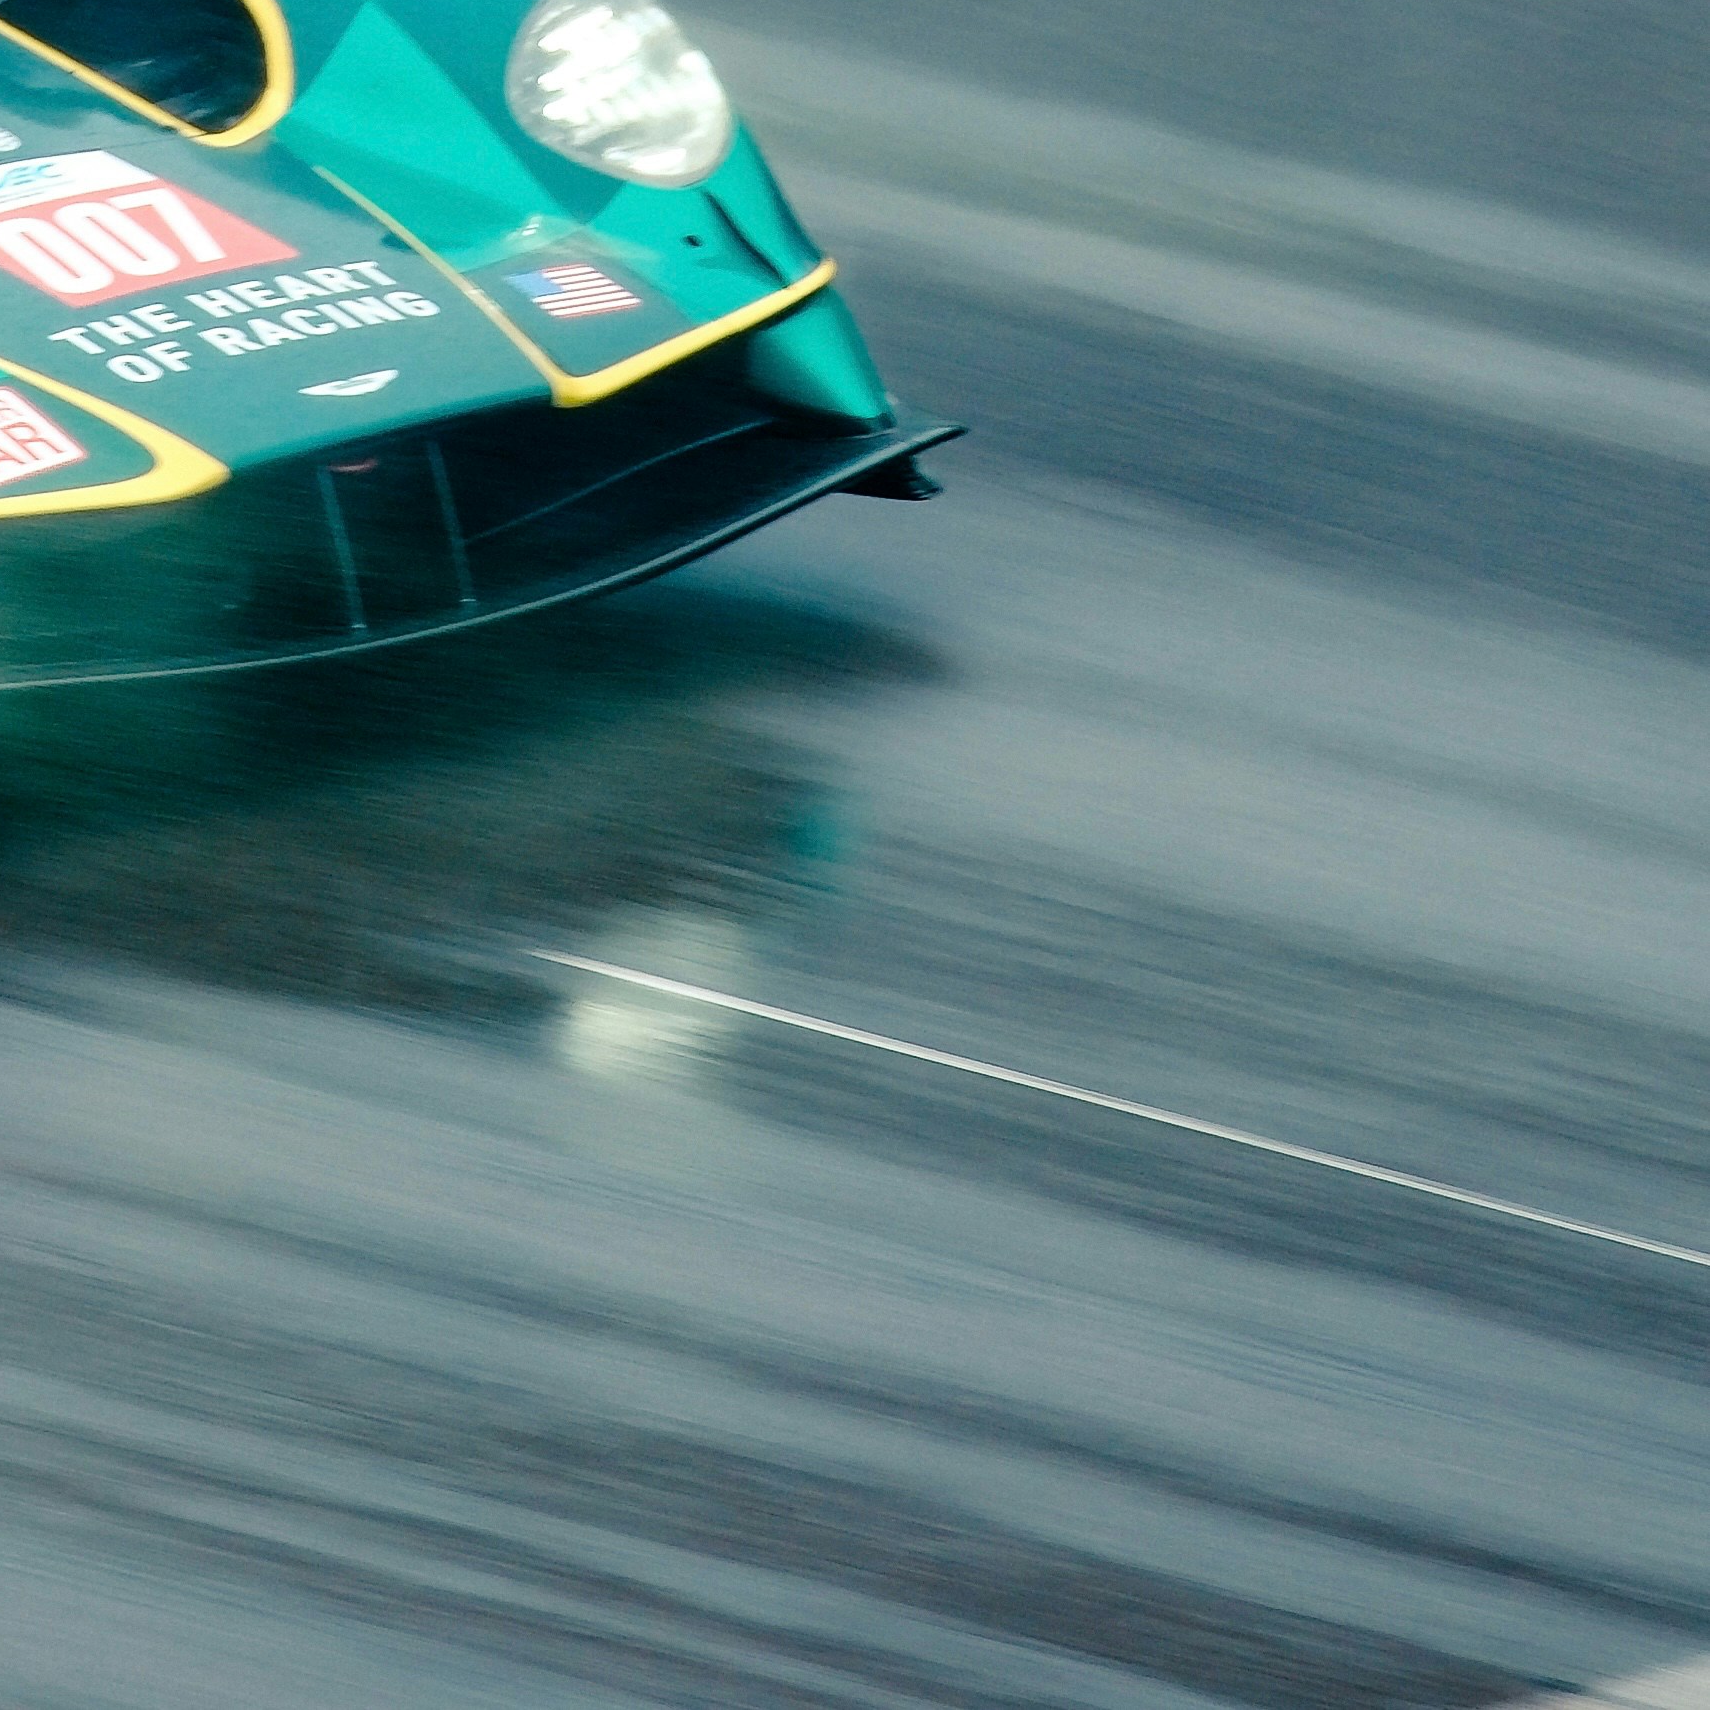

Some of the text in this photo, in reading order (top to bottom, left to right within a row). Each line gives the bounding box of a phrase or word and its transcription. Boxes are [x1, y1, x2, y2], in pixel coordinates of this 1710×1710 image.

[47, 260, 398, 355] THE HEART
[106, 291, 441, 383] OF RACING
